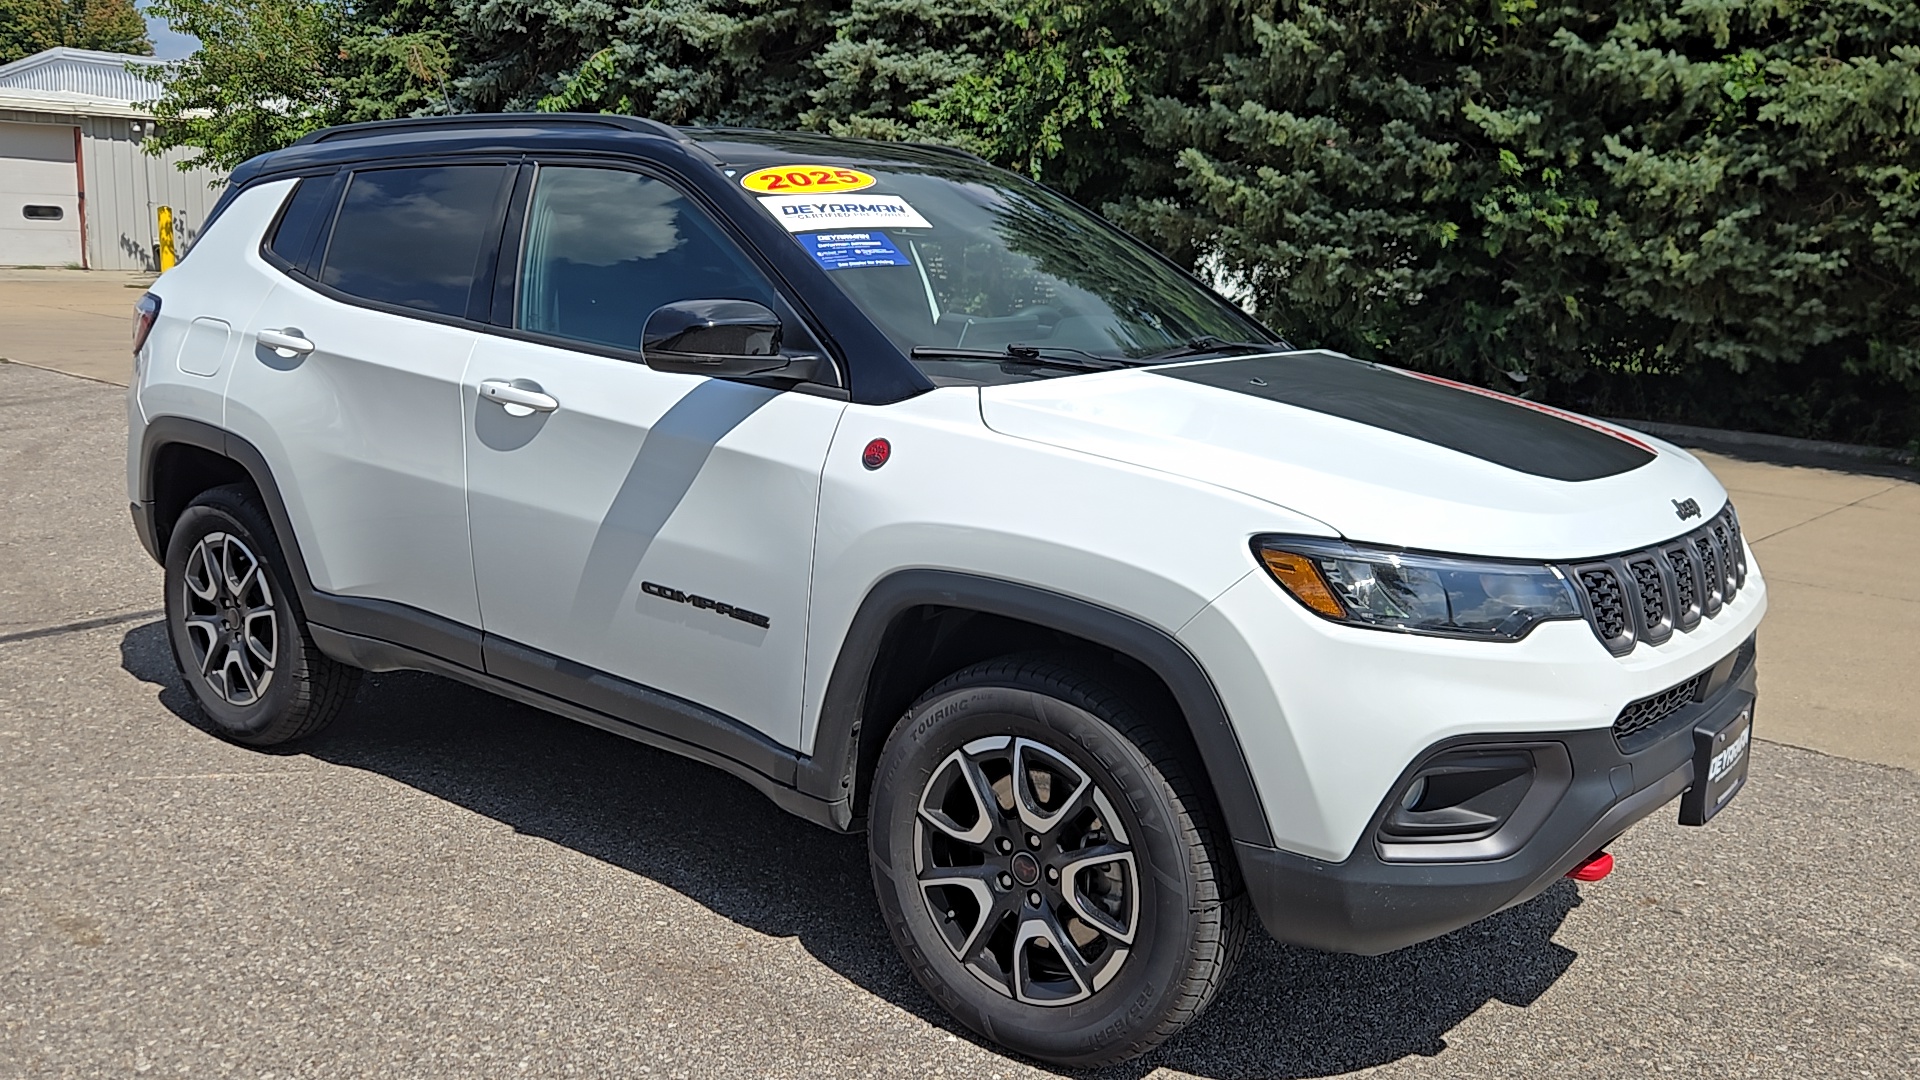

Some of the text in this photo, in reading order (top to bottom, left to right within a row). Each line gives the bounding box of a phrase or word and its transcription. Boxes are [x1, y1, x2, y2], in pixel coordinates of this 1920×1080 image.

[760, 171, 859, 190] 2025
[782, 203, 905, 215] DEYARMAN
[1670, 497, 1702, 522] Jeep
[640, 580, 771, 629] COMPASS
[909, 699, 969, 742] TOURING
[1068, 722, 1164, 834] KELLY
